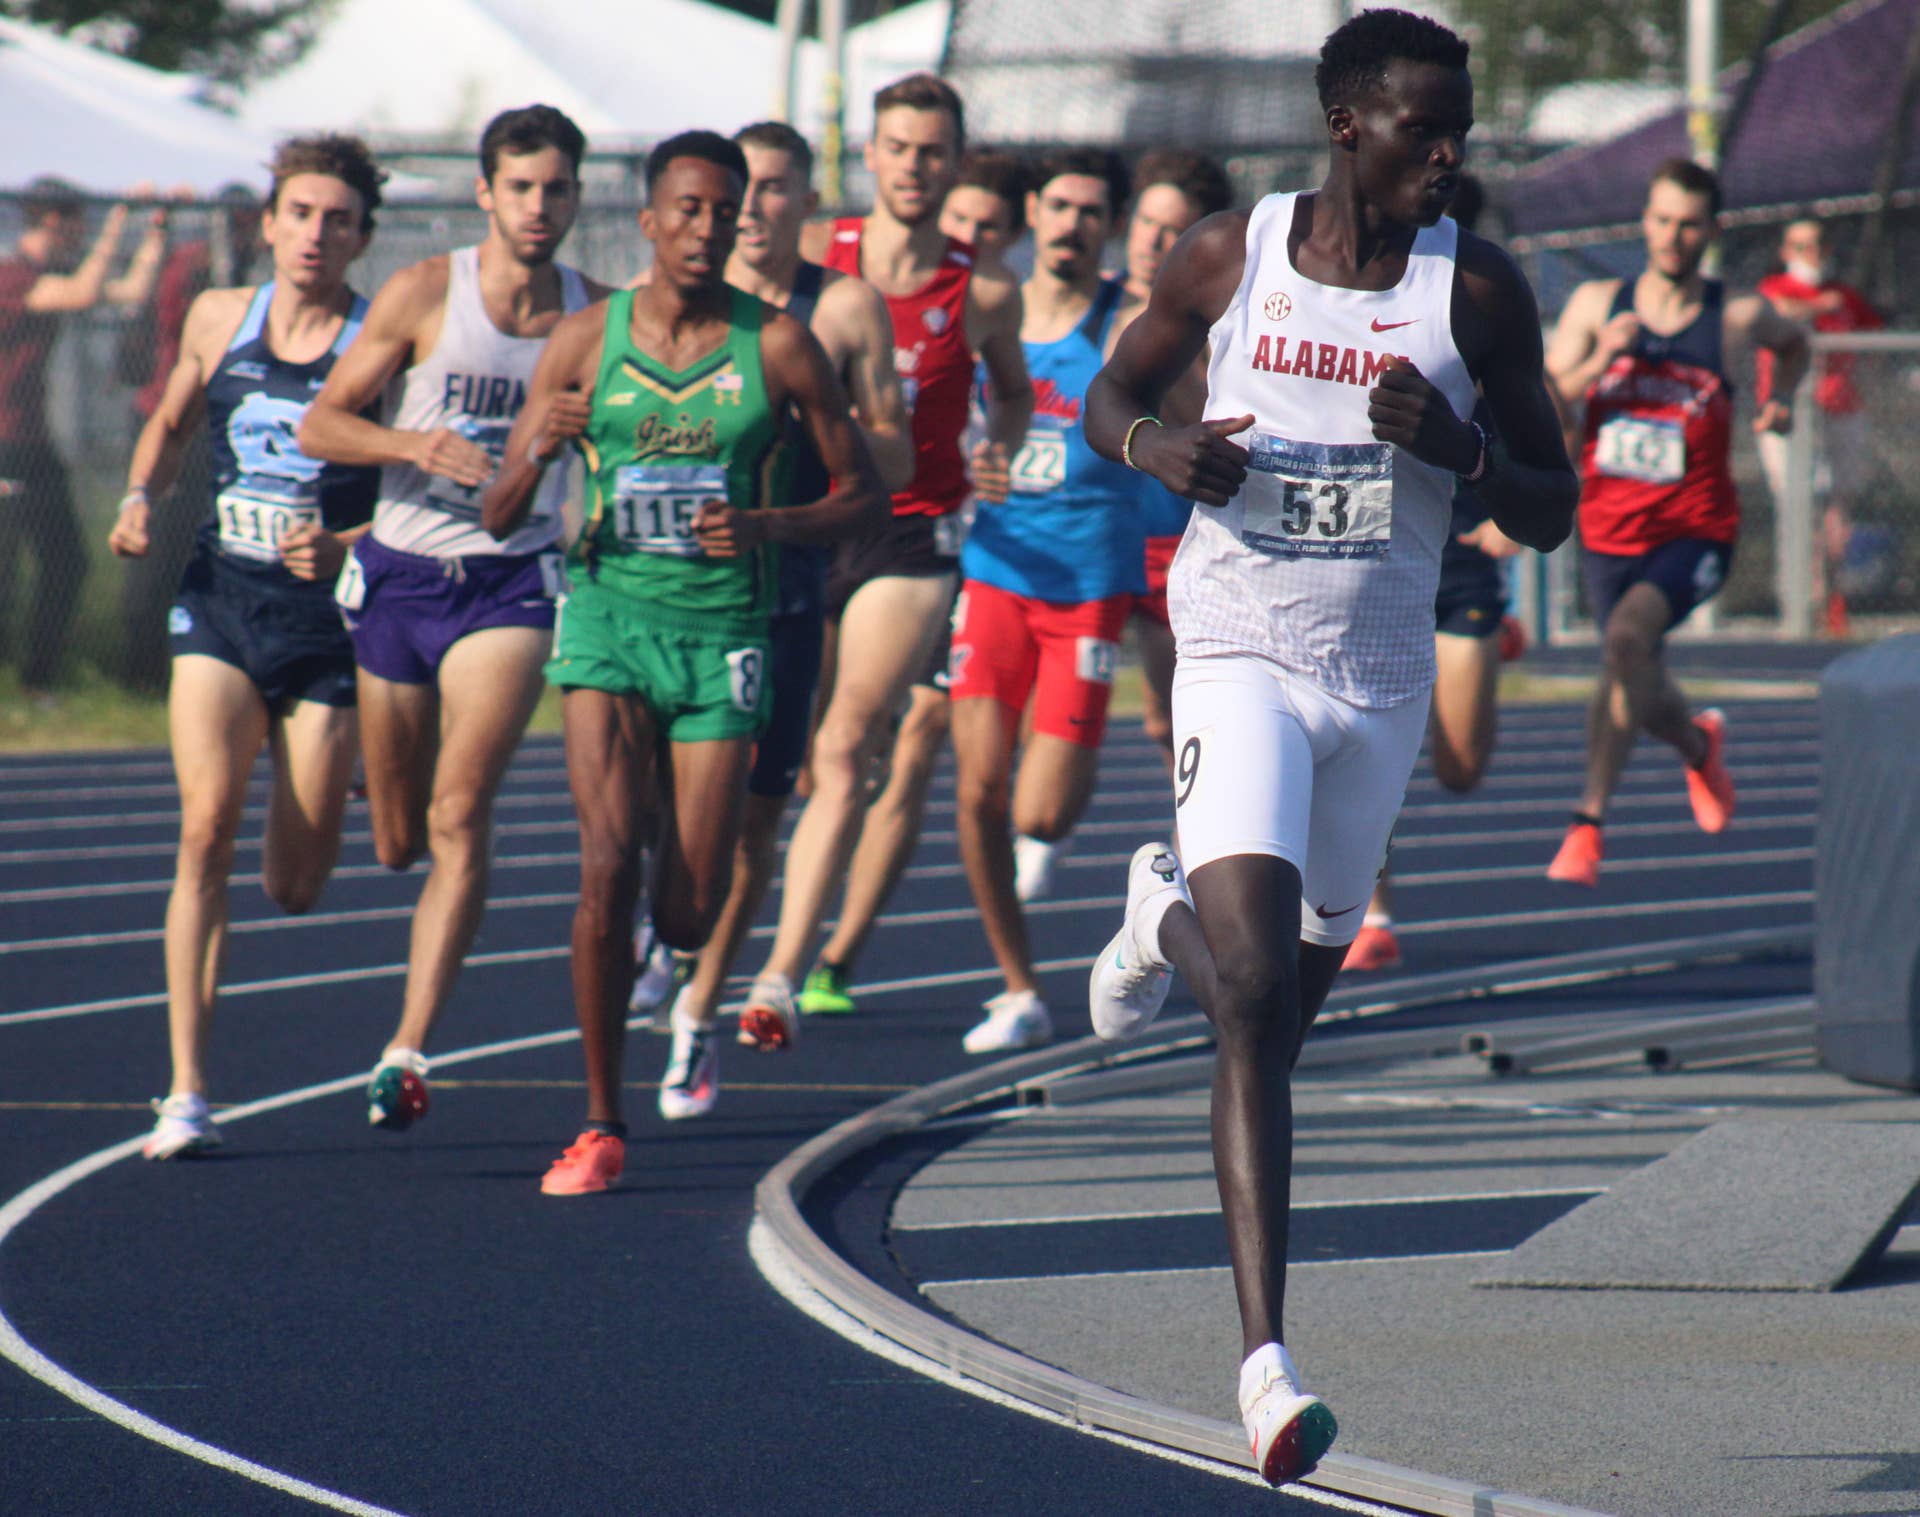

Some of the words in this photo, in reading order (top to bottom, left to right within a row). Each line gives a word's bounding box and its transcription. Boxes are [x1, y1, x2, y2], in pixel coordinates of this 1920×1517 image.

[1265, 292, 1292, 321] SEC
[1252, 335, 1410, 387] ALABAM
[635, 412, 717, 454] Irish
[1281, 480, 1349, 538] 53
[1177, 736, 1201, 809] 9
